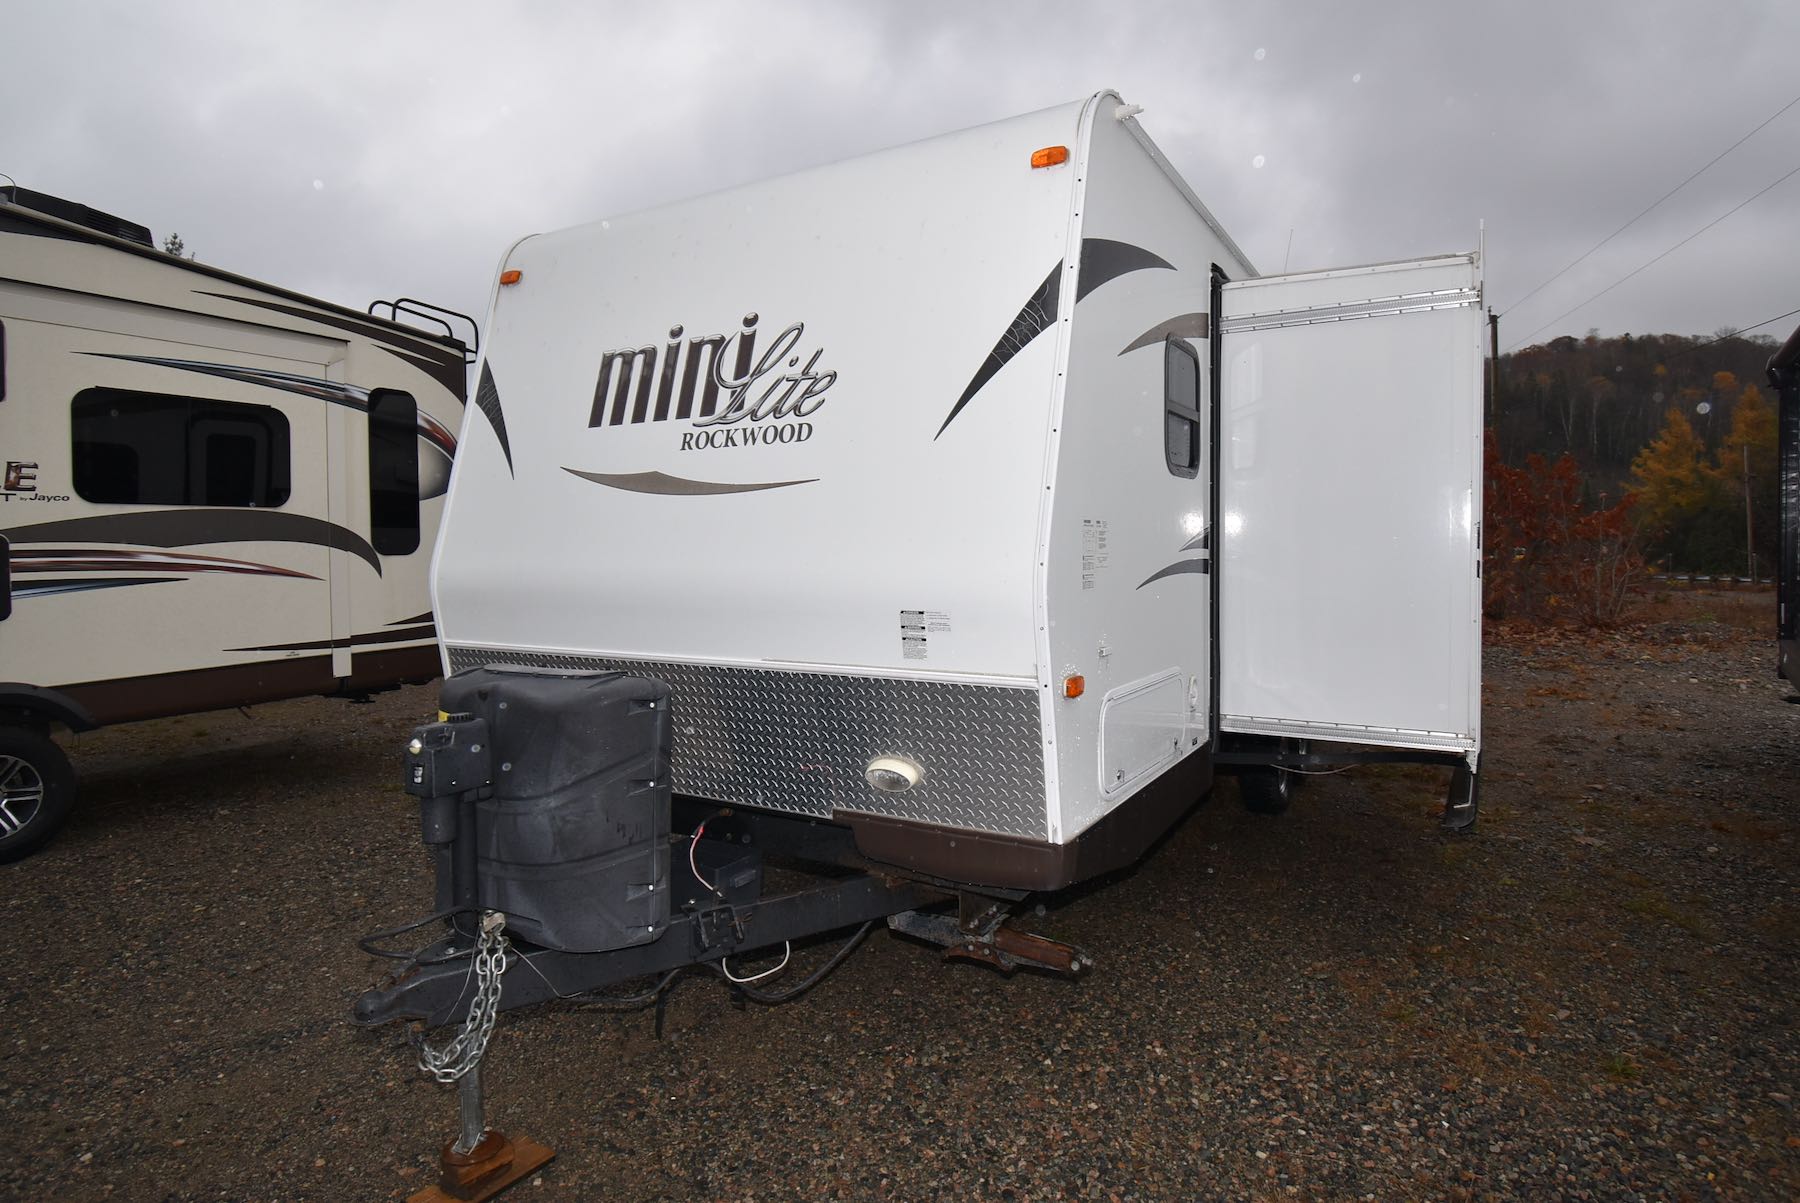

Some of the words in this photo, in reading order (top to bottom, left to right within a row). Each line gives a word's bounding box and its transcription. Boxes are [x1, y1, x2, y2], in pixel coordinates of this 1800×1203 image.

[588, 312, 759, 428] mini
[693, 322, 837, 427] lite
[680, 422, 813, 451] ROCKWOOD
[0, 461, 38, 491] E
[29, 493, 70, 502] Jayco
